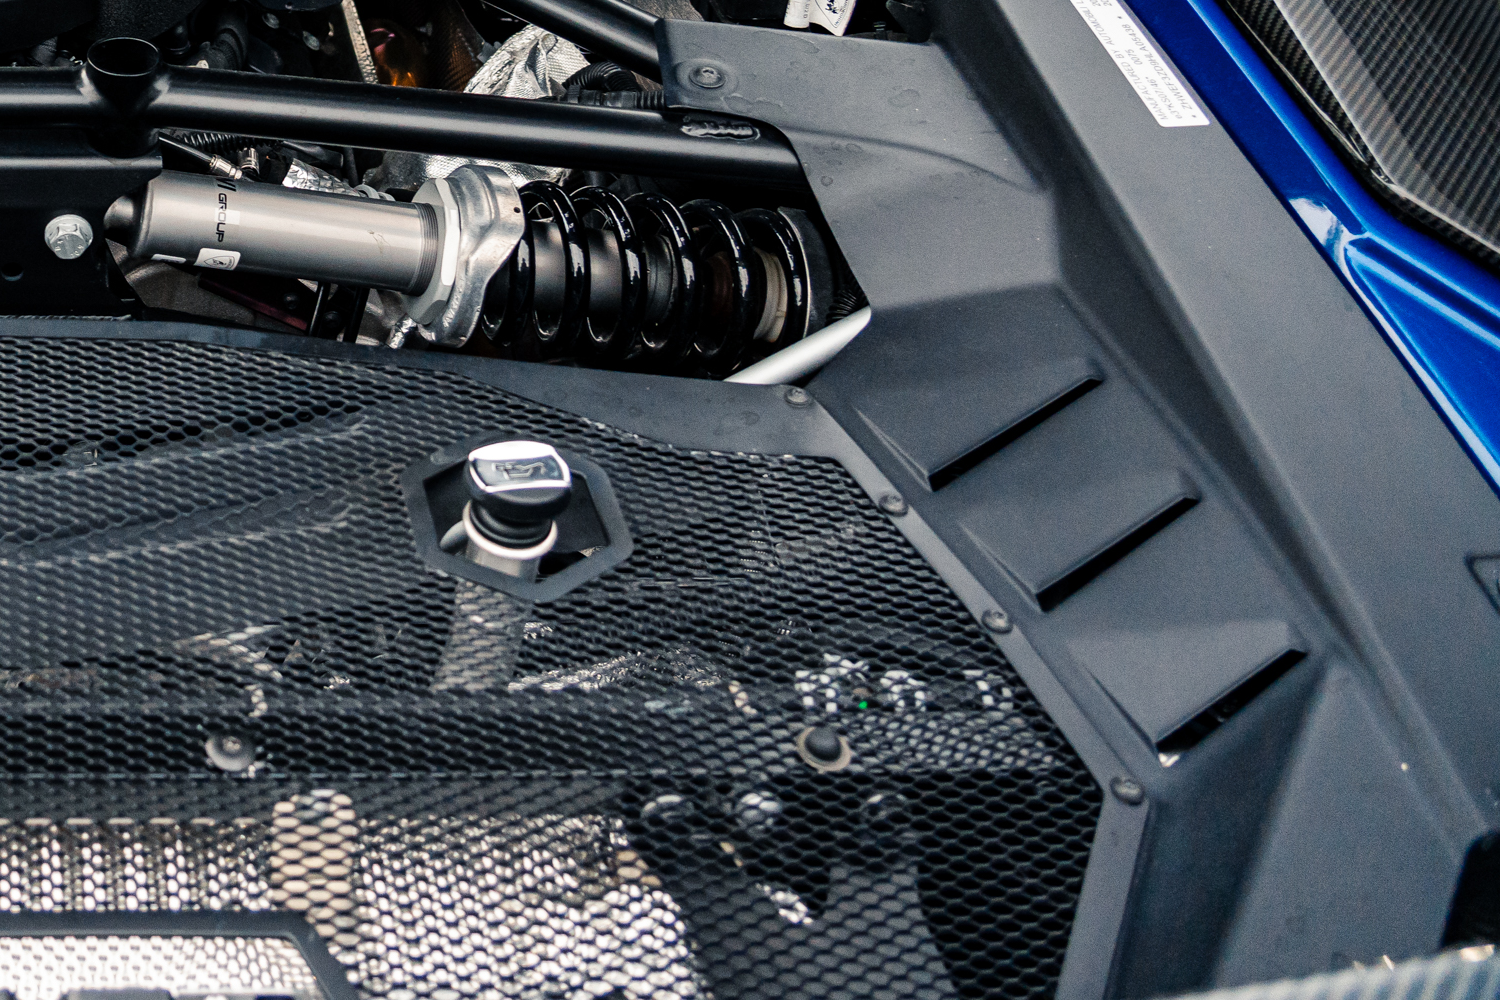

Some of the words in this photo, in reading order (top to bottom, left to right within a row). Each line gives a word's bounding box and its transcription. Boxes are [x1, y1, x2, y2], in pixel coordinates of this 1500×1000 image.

[1080, 6, 1116, 46] AUTOMOBILI
[1112, 49, 1125, 59] BY
[1120, 61, 1169, 120] MANUFACTURED
[215, 192, 228, 243] GROUP
